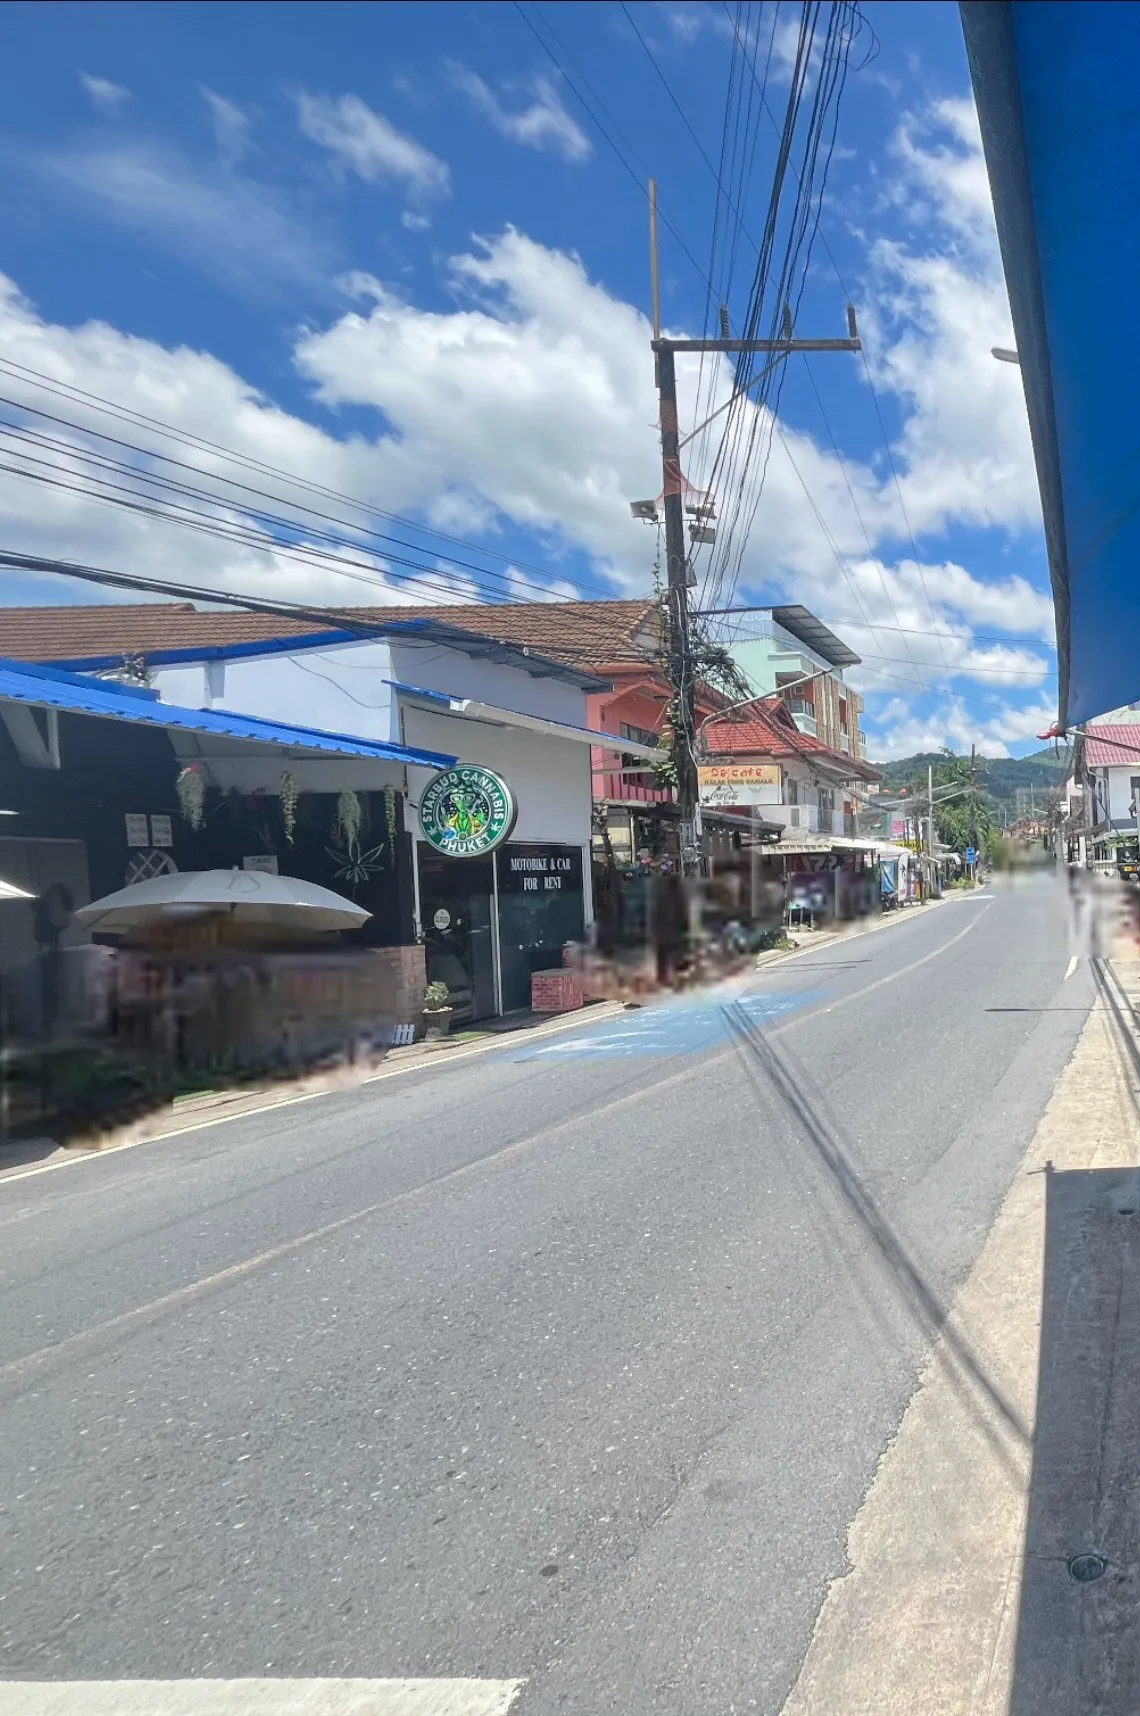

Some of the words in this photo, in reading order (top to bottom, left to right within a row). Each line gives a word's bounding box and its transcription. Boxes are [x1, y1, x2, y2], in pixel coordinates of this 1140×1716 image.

[422, 772, 458, 823] STARBUD
[461, 770, 505, 820] CANNABIS
[438, 833, 492, 852] PHUKET
[510, 858, 548, 871] MOTOBIKE
[550, 858, 556, 871] &
[557, 858, 571, 871] CAR
[523, 877, 538, 890] FOR
[544, 876, 562, 889] RENT
